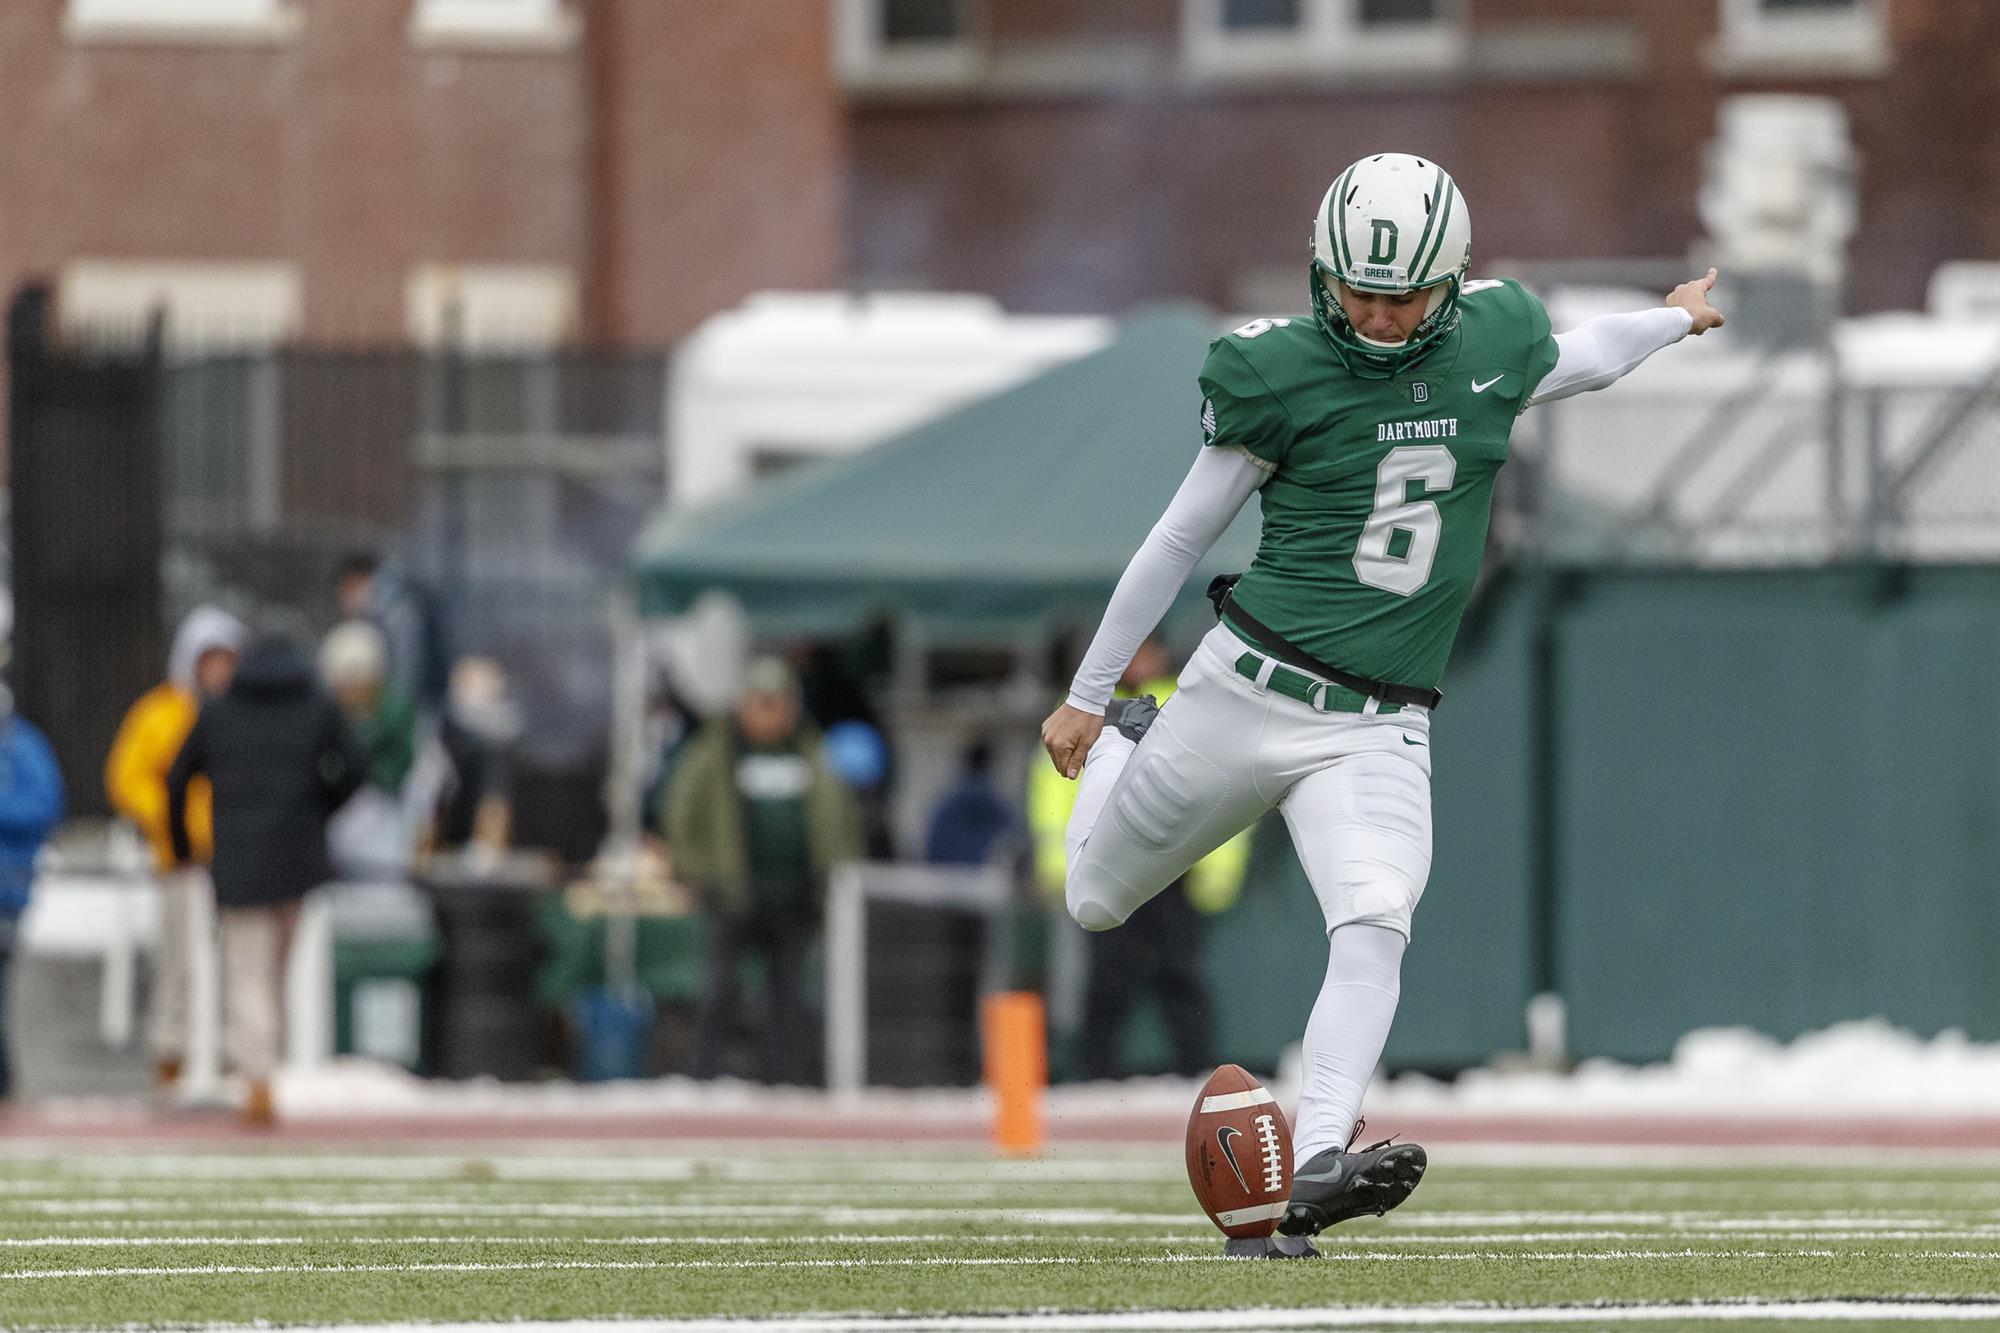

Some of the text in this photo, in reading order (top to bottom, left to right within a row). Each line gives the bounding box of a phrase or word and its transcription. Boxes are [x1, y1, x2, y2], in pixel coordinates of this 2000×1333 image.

[1368, 219, 1399, 265] D
[1364, 267, 1393, 279] GREEN
[1321, 289, 1348, 320] Riddell
[1412, 382, 1429, 403] D
[1377, 418, 1458, 442] DARTMOUTH
[1352, 444, 1458, 598] 6
